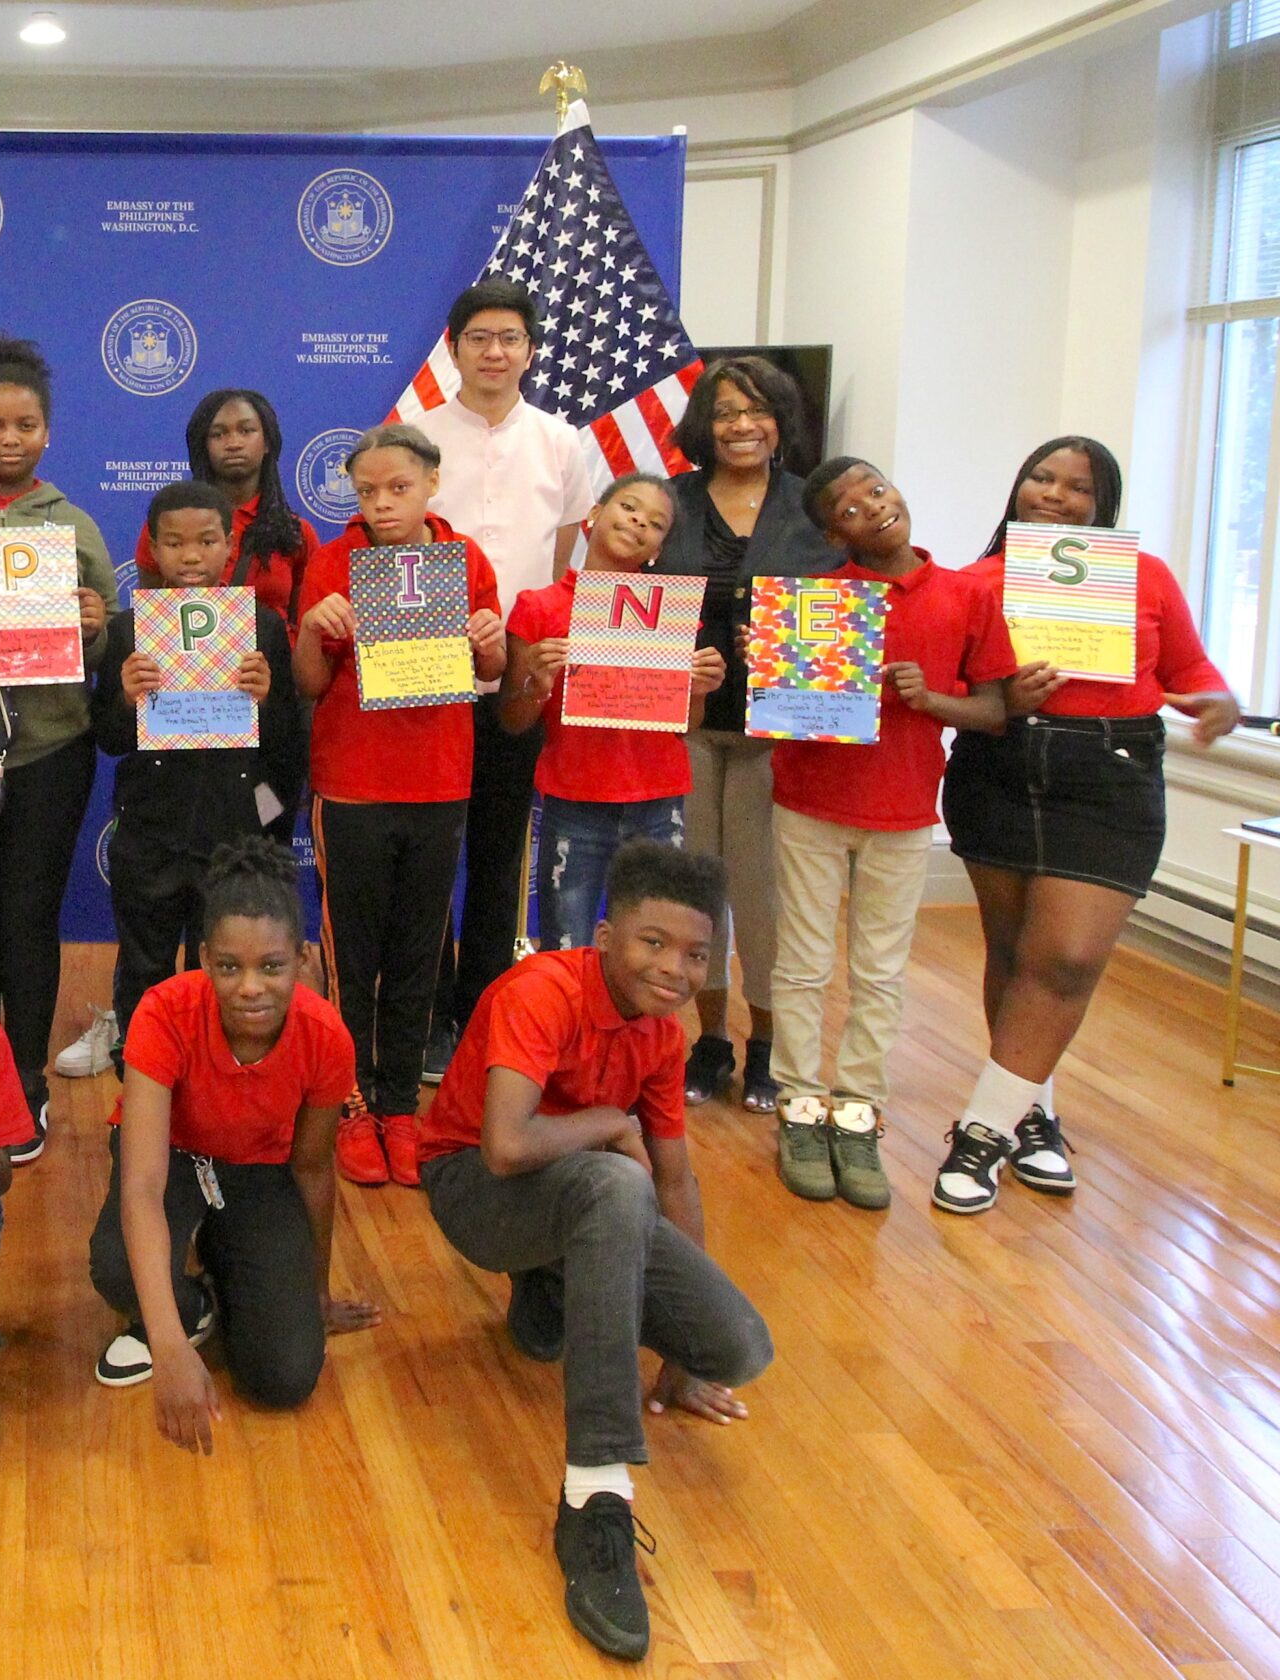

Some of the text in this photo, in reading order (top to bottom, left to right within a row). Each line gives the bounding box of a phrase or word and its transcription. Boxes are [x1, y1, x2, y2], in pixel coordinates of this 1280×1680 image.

[107, 201, 194, 211] EMBASSY OF THE
[119, 212, 184, 221] PHILIPPINES
[101, 222, 199, 233] WASHINGTON, D.C.
[302, 333, 388, 343] EMBASSY OF THE
[314, 344, 378, 353] PHILIPPINES
[296, 354, 393, 365] WASHINGTON, D.C.
[105, 461, 152, 470] EMBASSY
[154, 462, 169, 470] OF
[118, 472, 182, 481] PHILIPPINES
[3, 542, 39, 591] P
[1048, 537, 1090, 585] S
[396, 553, 425, 607] I
[608, 584, 664, 631] N
[800, 590, 838, 642] E
[180, 600, 218, 651] P
